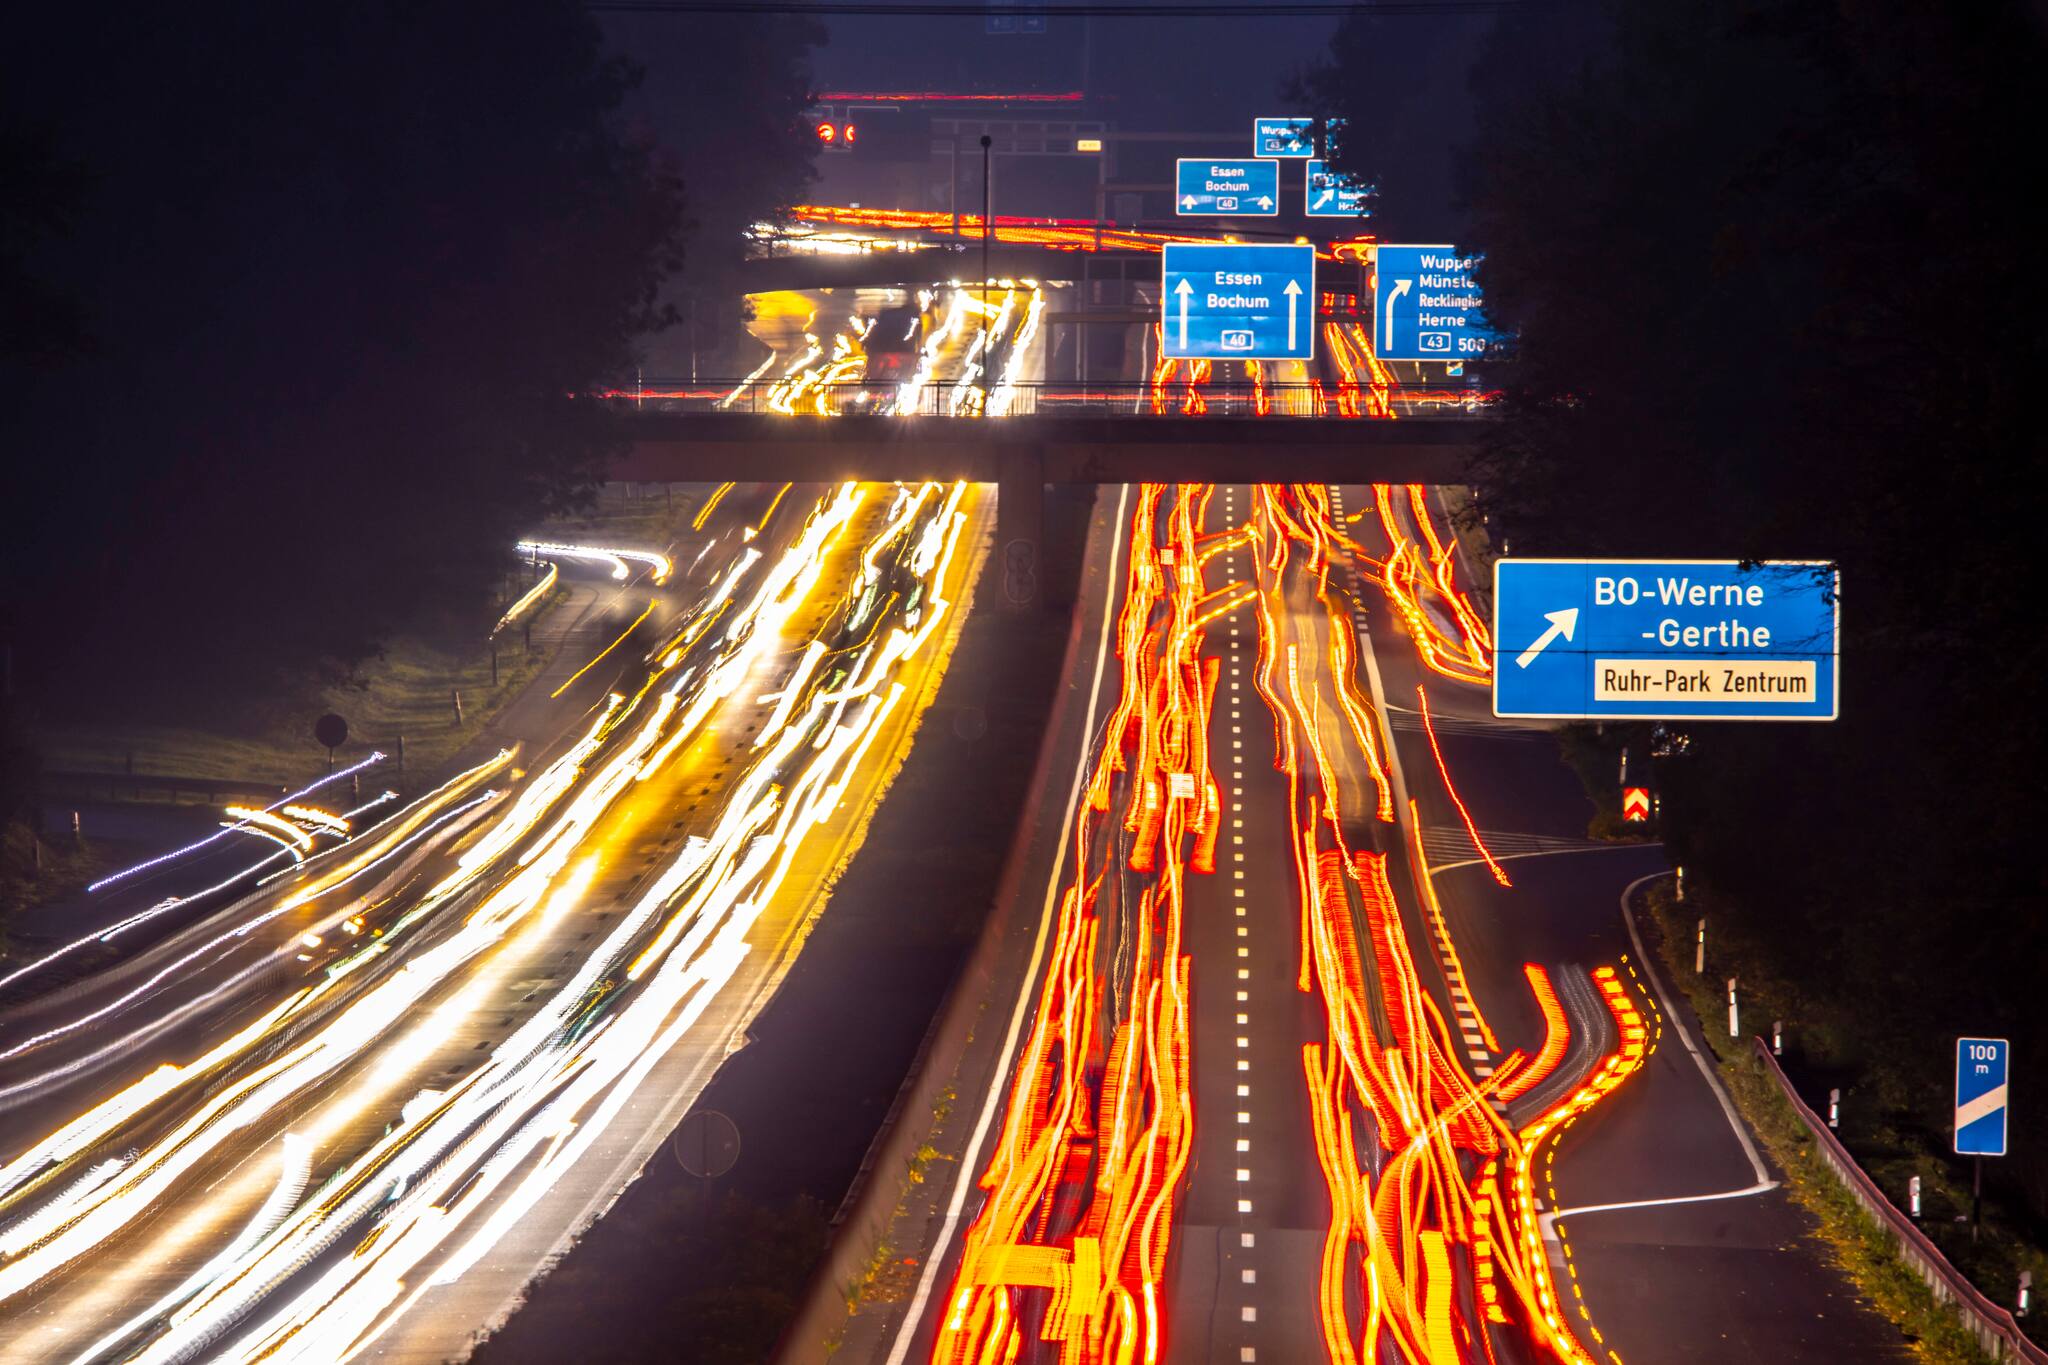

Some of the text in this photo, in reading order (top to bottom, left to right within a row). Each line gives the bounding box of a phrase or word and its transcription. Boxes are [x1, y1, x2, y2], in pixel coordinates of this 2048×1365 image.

[1211, 166, 1245, 177] Essen
[1205, 181, 1250, 192] Bochum
[1221, 199, 1233, 208] 40
[1215, 271, 1262, 286] Essen
[1419, 274, 1475, 289] Münste
[1207, 293, 1270, 309] Bochum
[1418, 312, 1466, 327] Herne
[1229, 334, 1246, 346] 40
[1427, 336, 1444, 349] 43
[1594, 576, 1764, 607] BO-Werne
[1641, 618, 1772, 648] -Gerthe
[1605, 669, 1807, 693] Ruhr-Park Zentrum
[1969, 1044, 1997, 1061] 100
[1975, 1064, 1989, 1074] m
